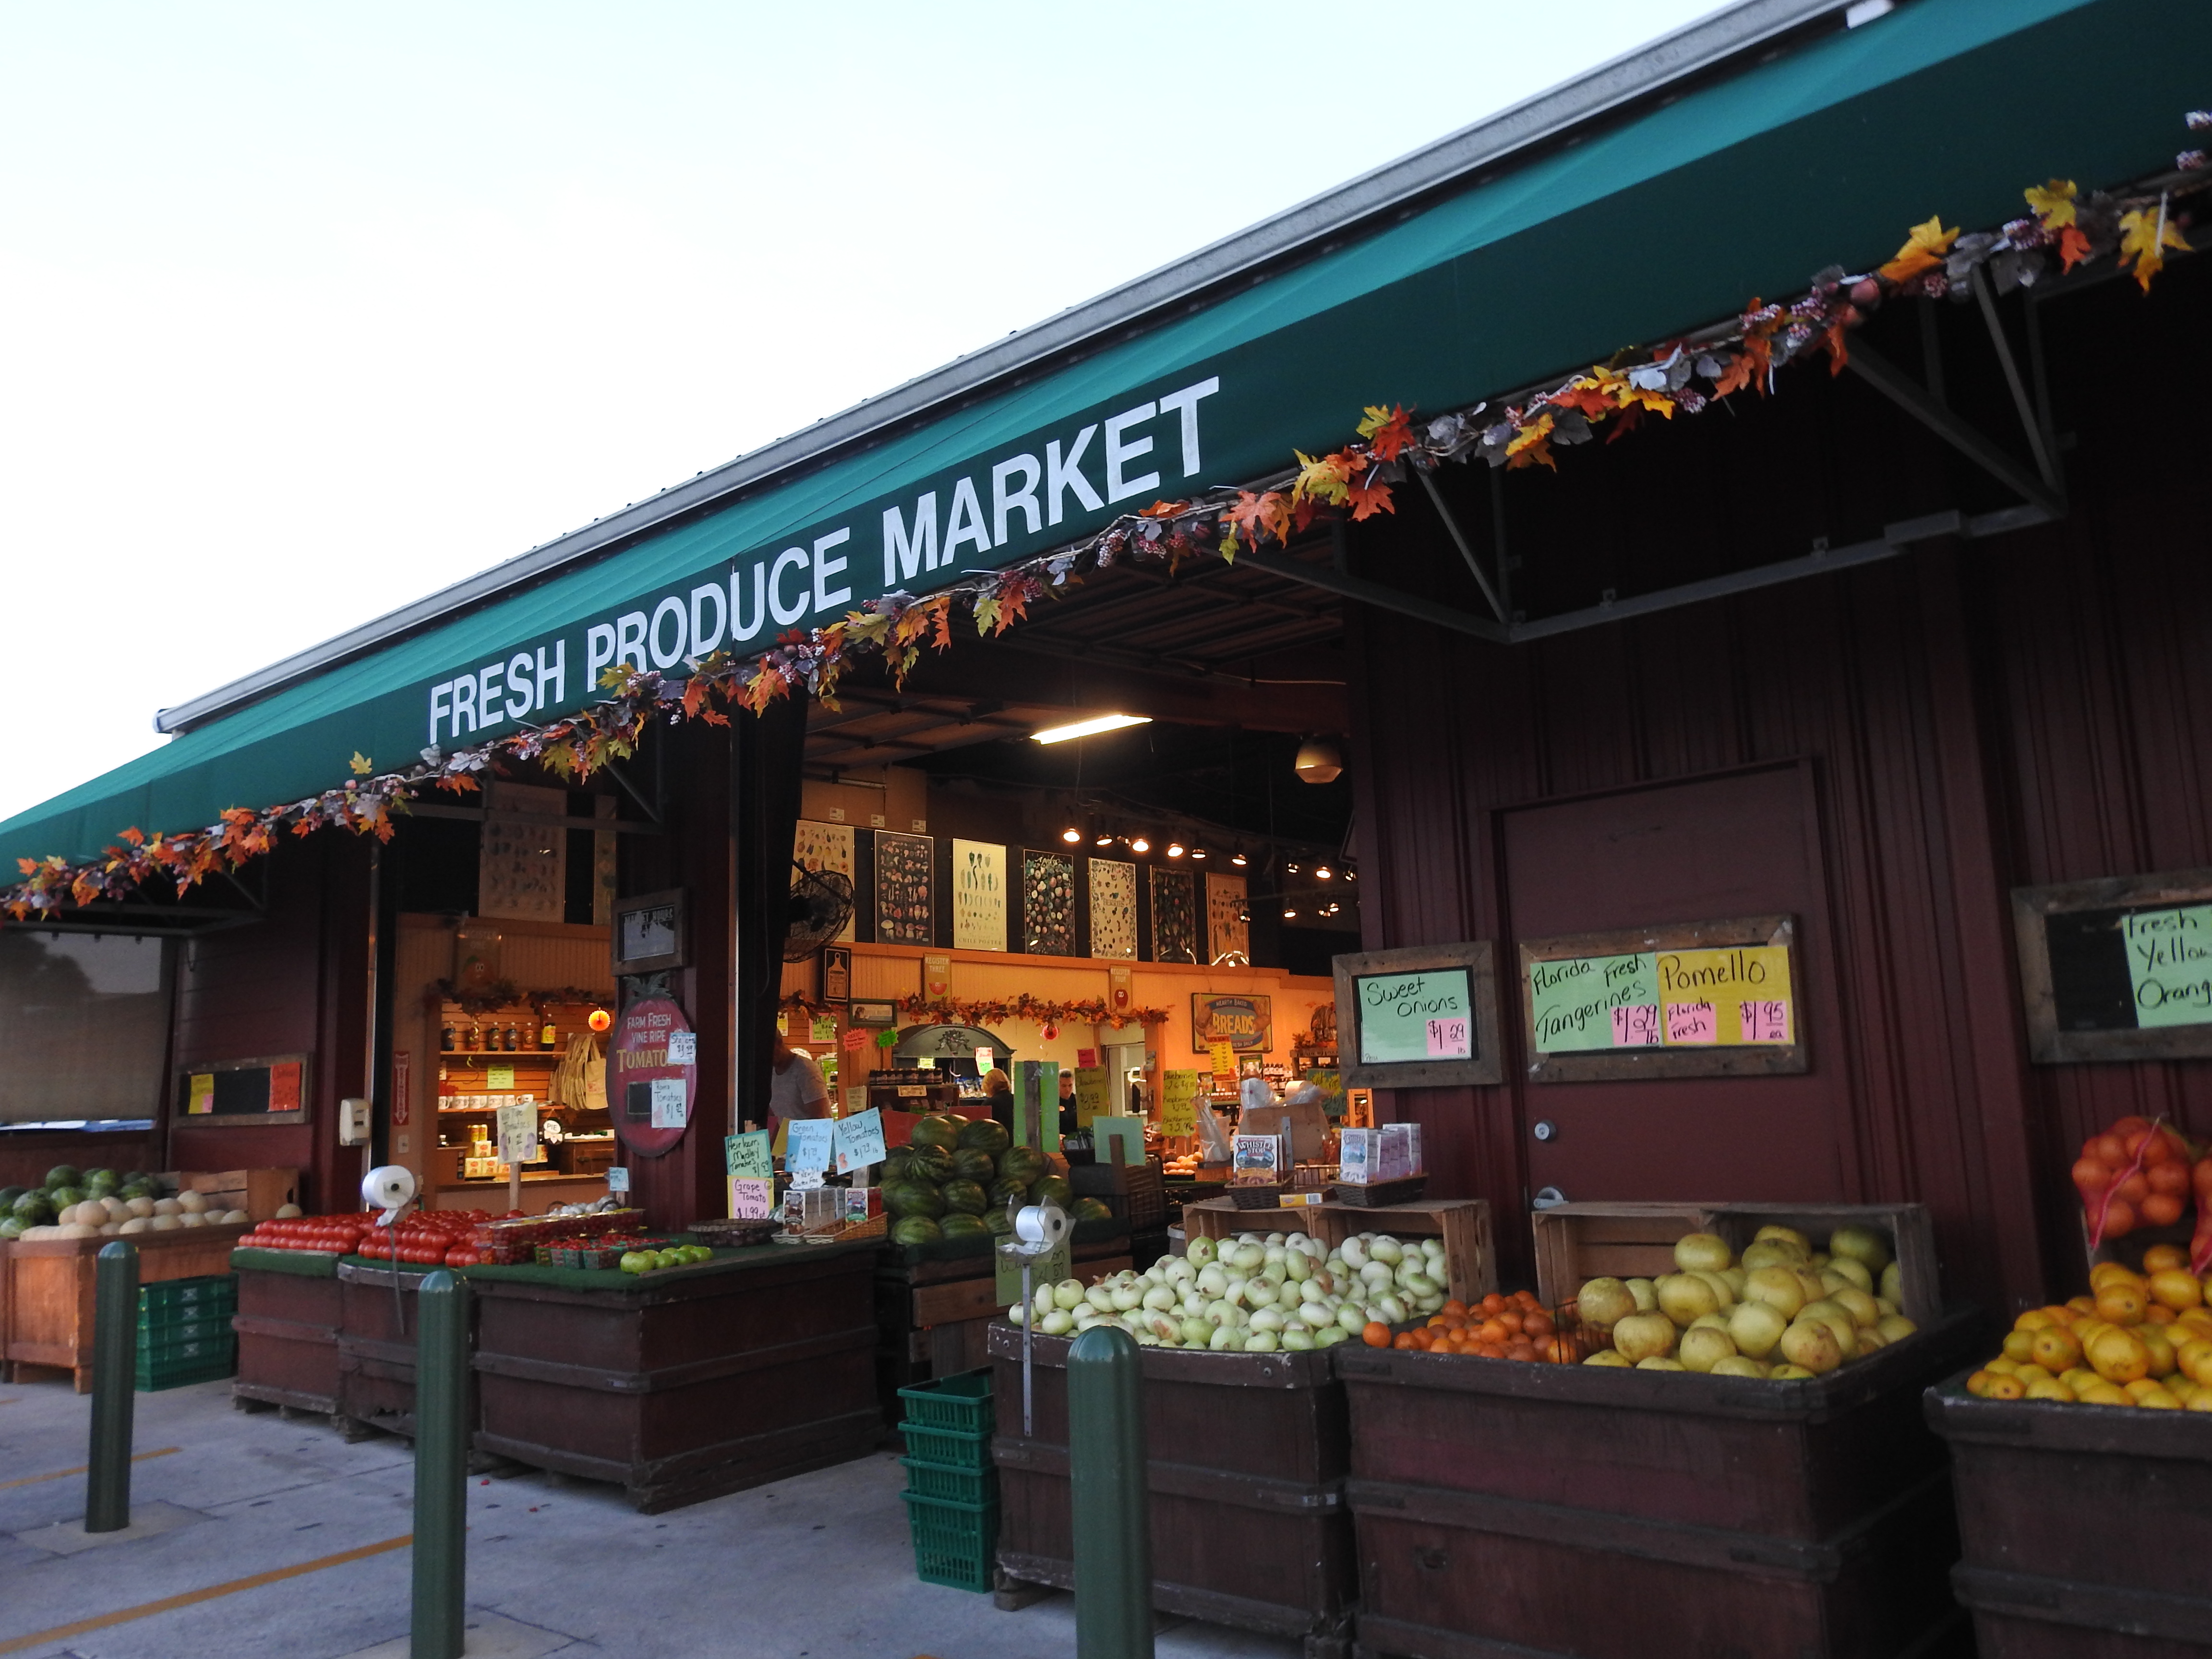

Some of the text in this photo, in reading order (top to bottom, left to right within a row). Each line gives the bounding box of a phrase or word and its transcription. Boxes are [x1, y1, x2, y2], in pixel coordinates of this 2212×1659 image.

[428, 376, 1220, 745] FRESH PRODUCE MARKET
[925, 957, 950, 965] REGISTER
[929, 965, 945, 974] THREE
[1533, 953, 1647, 996] Florida Fresh
[1656, 950, 1766, 992] Pomello
[1367, 976, 1425, 1006] Sweet
[2137, 977, 2212, 1010] Orang
[1536, 980, 1647, 1044] Tangerines
[1668, 996, 1712, 1022] Florida
[627, 1012, 672, 1030] FARM FRESH
[1212, 1012, 1255, 1035] BREADS
[631, 1030, 667, 1044] VINE RIPE
[547, 1122, 557, 1131] PIE
[792, 1123, 814, 1133] Green
[838, 1120, 863, 1136] Yellow
[798, 1132, 828, 1143] Tomatoes
[845, 1126, 880, 1144] Tomatoes
[1237, 1141, 1275, 1151] WHISTLE
[734, 1179, 760, 1192] Grape
[738, 1191, 767, 1203] Tomato
[737, 1206, 759, 1218] $1.99
